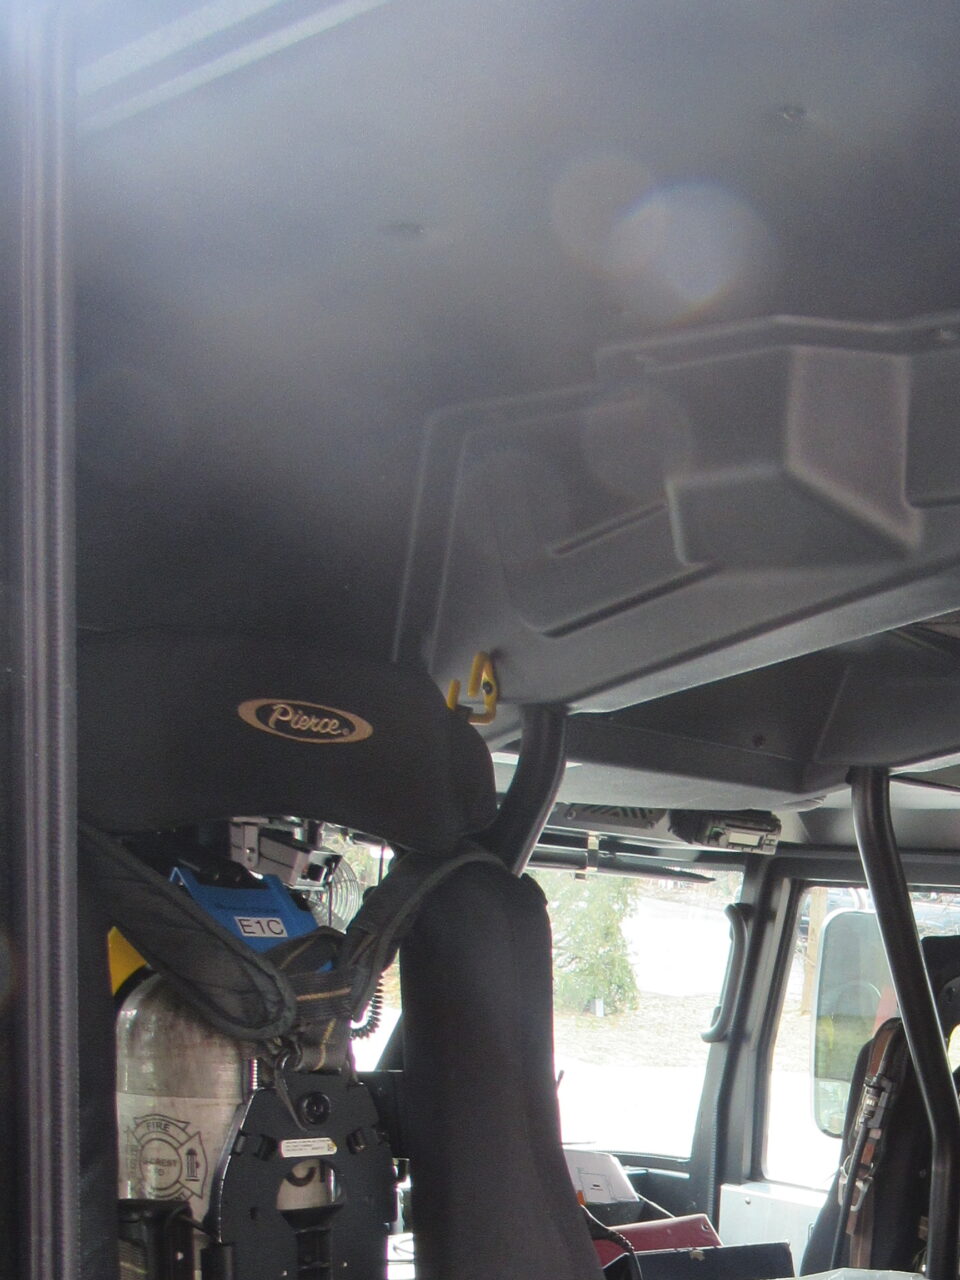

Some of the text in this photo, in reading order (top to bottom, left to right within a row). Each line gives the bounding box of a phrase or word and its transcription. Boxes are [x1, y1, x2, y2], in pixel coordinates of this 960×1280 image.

[268, 704, 342, 735] Pierce
[238, 918, 284, 935] E1C
[146, 1121, 170, 1132] FIRE
